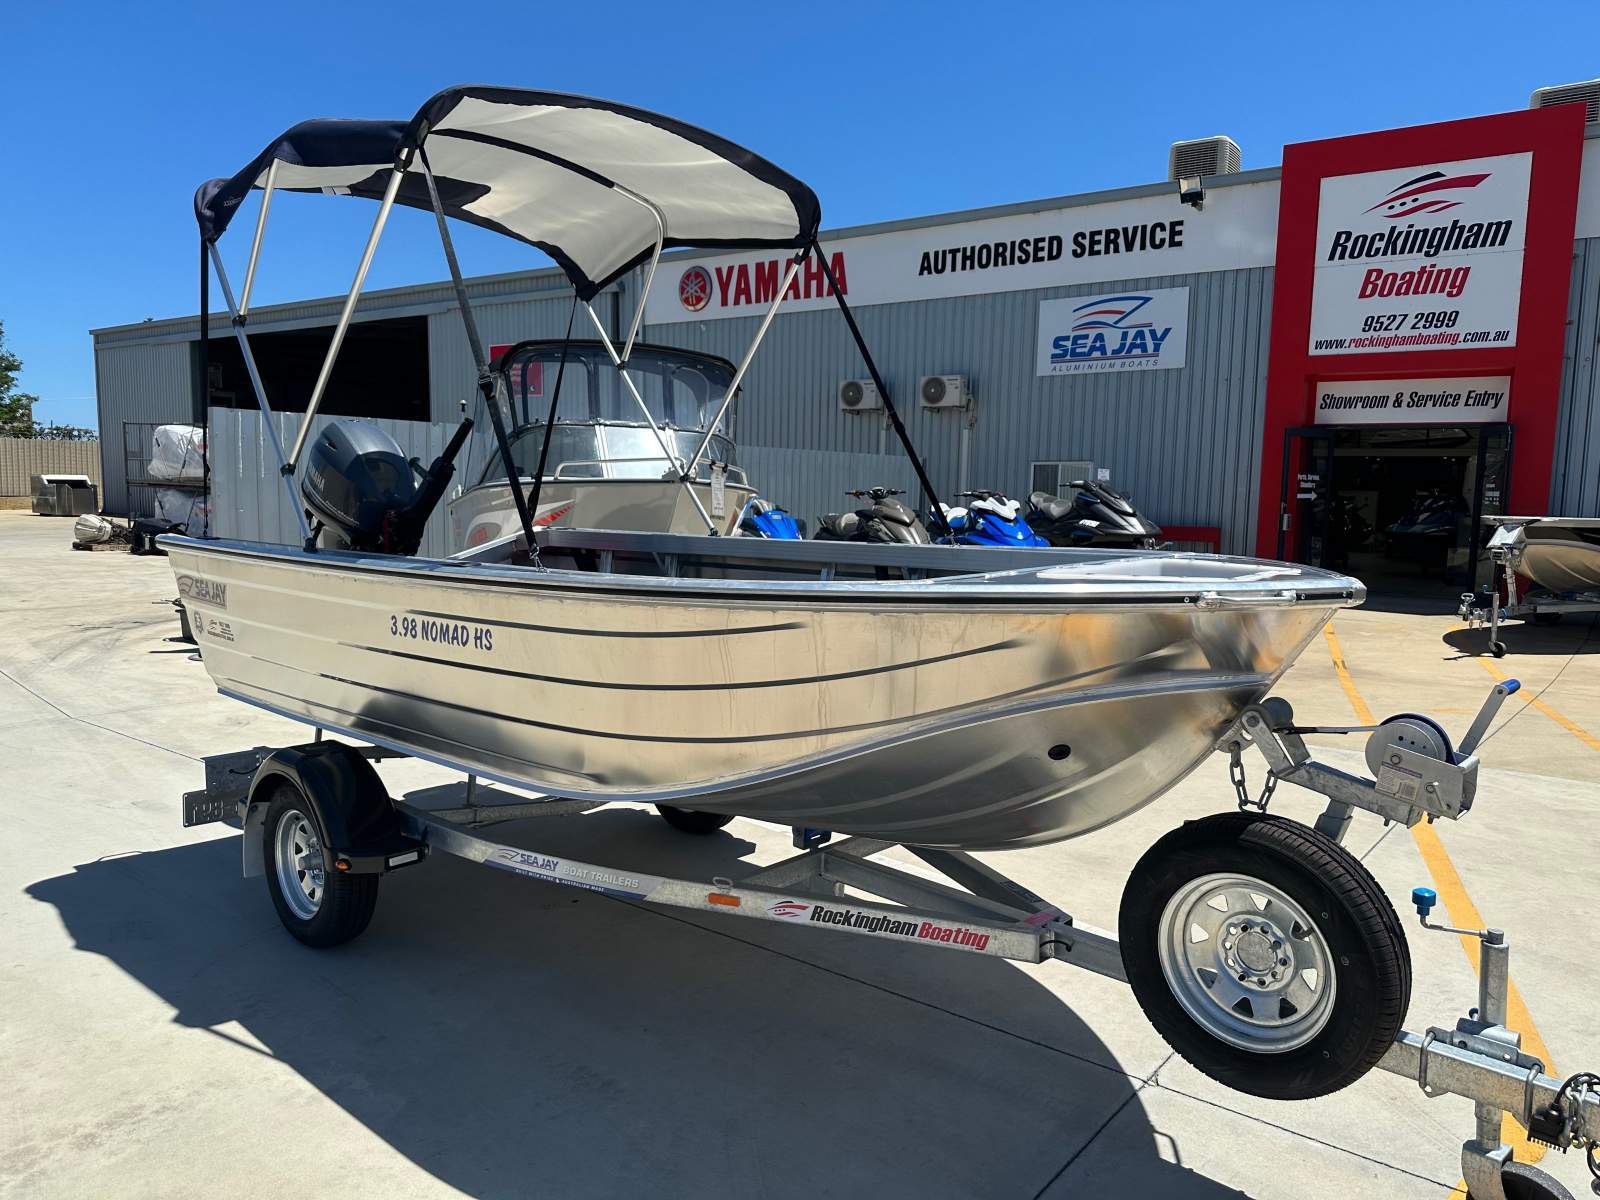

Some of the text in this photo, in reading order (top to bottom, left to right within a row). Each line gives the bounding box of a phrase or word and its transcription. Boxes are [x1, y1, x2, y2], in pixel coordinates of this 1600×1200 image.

[918, 220, 1185, 276] AUTHORISED SERVICE
[1328, 219, 1512, 262] Rockingham
[715, 252, 848, 307] YAMAHA
[1358, 264, 1471, 299] Boating
[1362, 310, 1460, 333] 9527 2999
[1051, 327, 1172, 360] SEA JAY
[1314, 329, 1510, 350] www.rockinghamboating.com.au
[1051, 358, 1159, 373] ALUMINIUM BOATS
[1320, 389, 1504, 410] Showroom & Service Entry
[211, 582, 227, 605] JAY
[391, 615, 493, 651] 3.98 NOMAD HS
[520, 853, 639, 888] SEA JAY BOAT TRAILERS
[810, 905, 991, 951] Rockingham Boating
